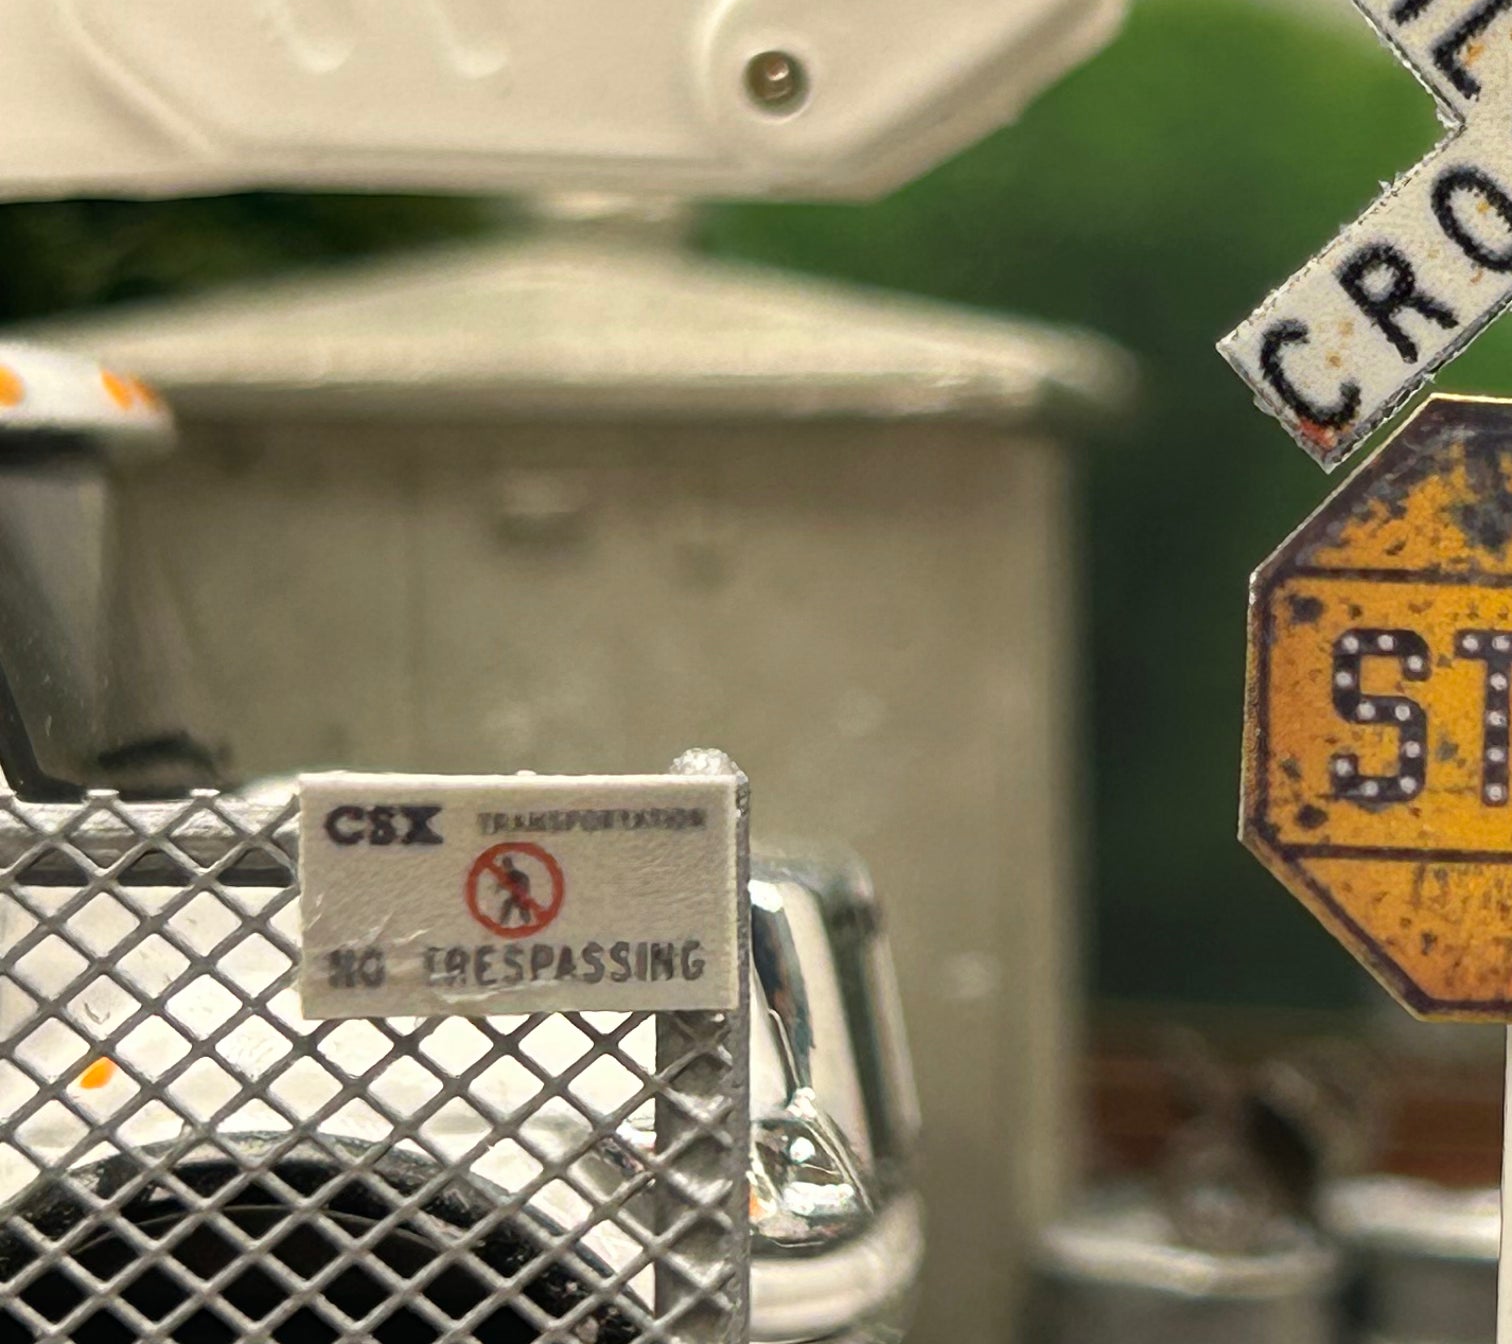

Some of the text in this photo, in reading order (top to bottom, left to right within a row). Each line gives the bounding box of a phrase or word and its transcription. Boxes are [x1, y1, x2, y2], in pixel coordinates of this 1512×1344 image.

[323, 805, 443, 846] CSX
[327, 940, 706, 989] NO TRESPASSING
